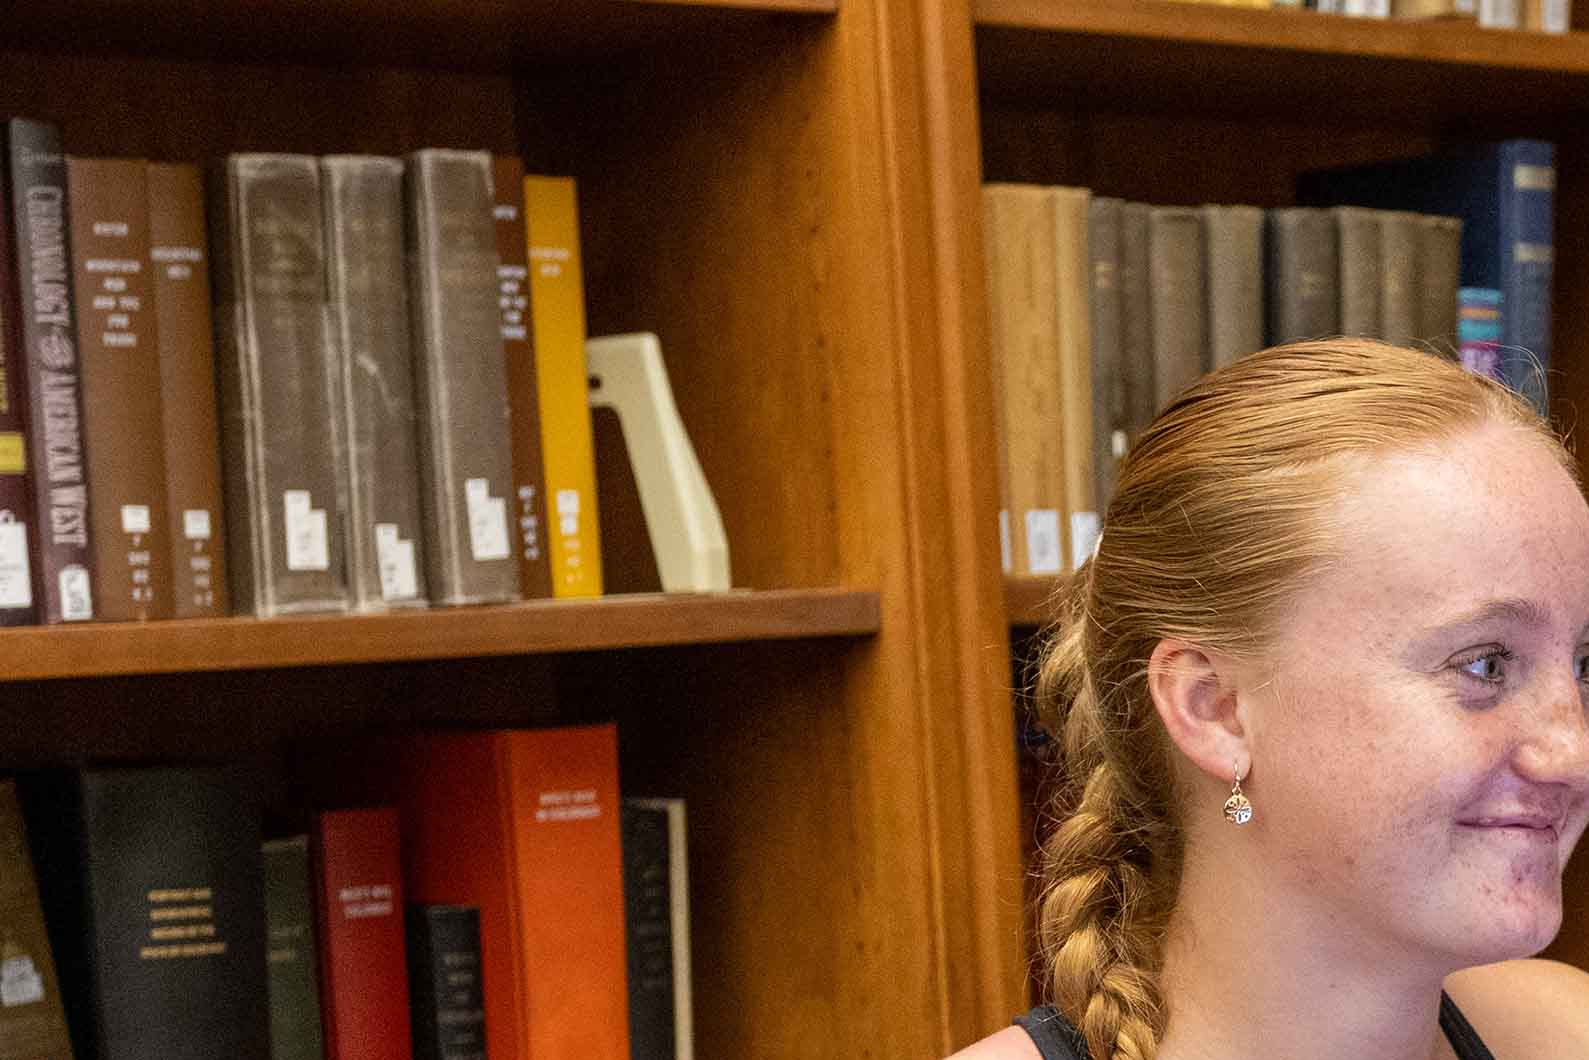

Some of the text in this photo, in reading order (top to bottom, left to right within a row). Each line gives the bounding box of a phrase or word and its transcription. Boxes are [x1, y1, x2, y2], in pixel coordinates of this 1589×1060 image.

[26, 185, 70, 327] CHRONOLOGY
[40, 370, 84, 482] AMERICAN
[49, 482, 89, 547] WEST
